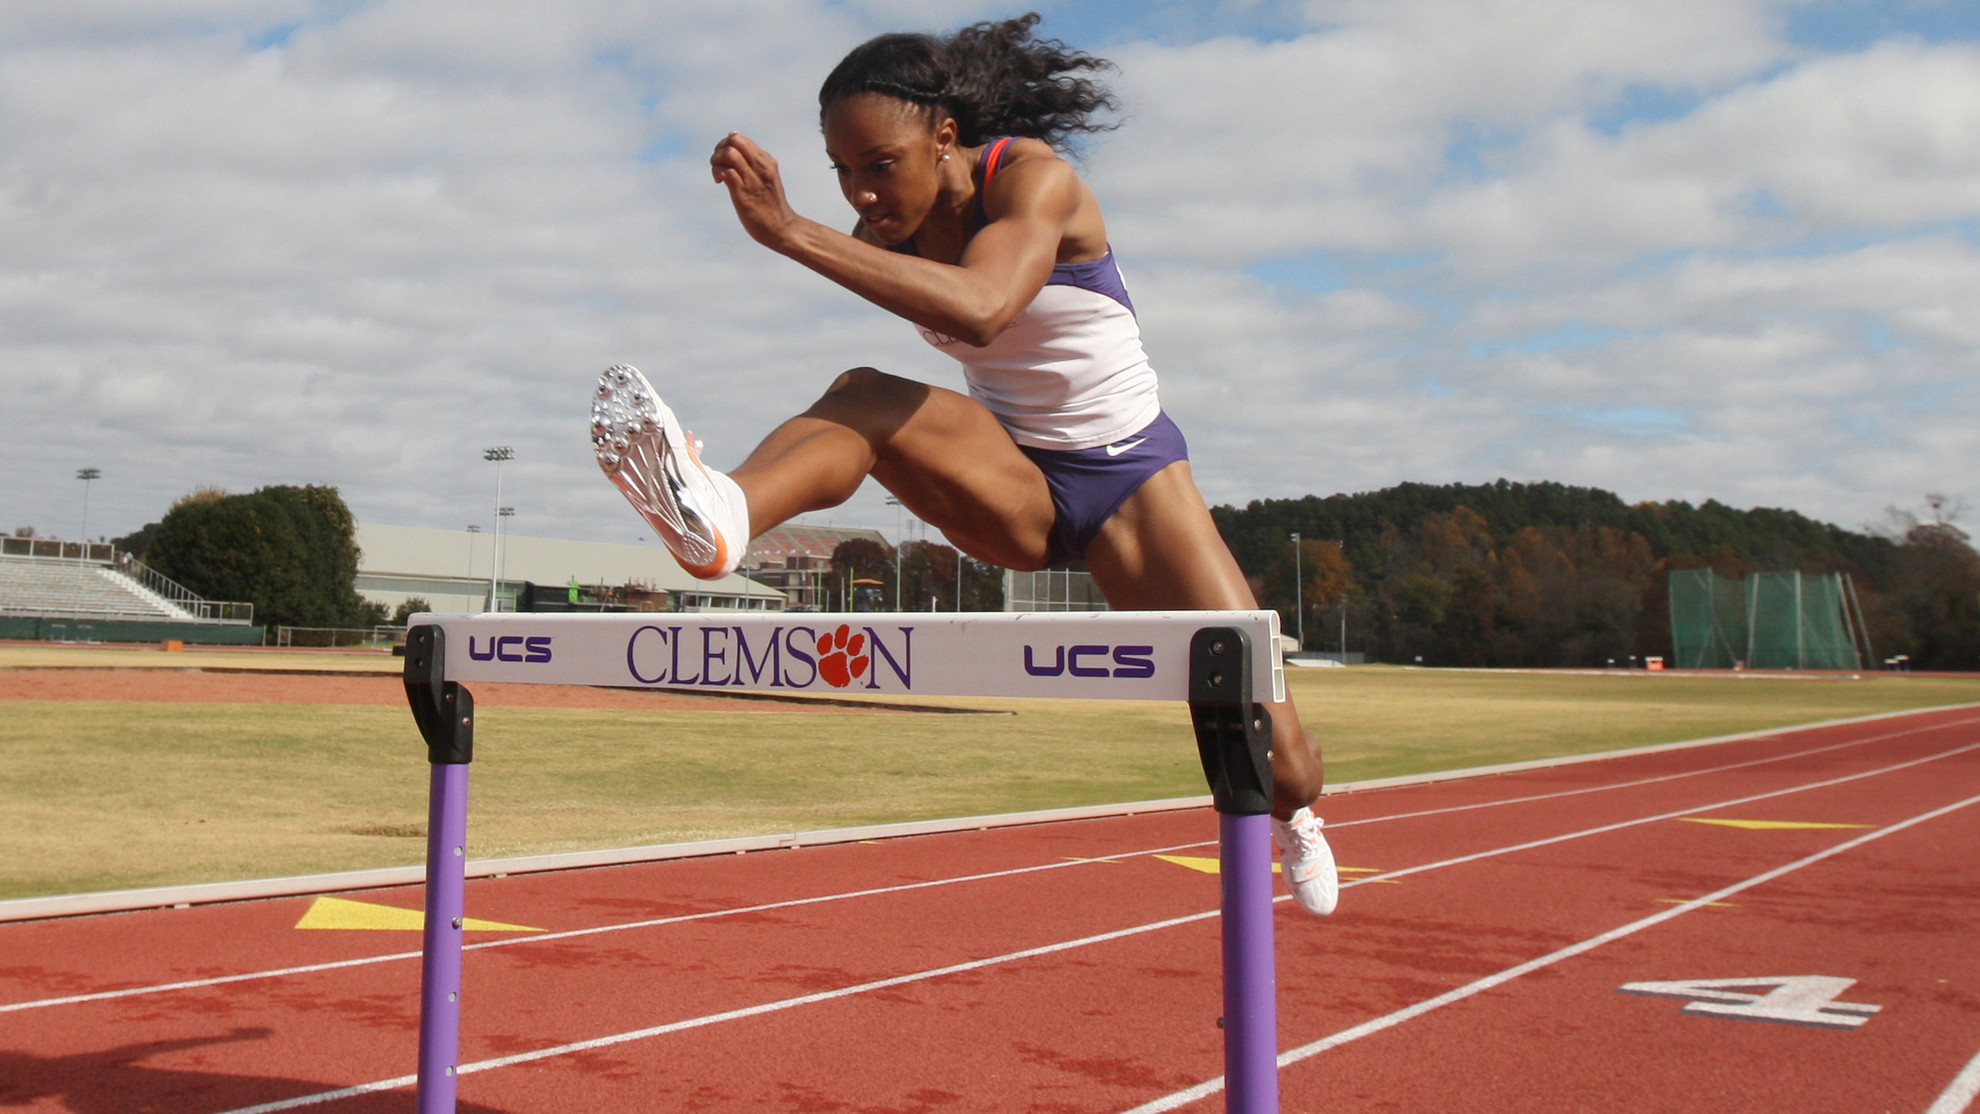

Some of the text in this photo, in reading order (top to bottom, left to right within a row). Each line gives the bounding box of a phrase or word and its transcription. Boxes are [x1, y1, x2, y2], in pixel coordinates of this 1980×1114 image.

[469, 635, 552, 663] UCS
[1024, 645, 1155, 678] UCS
[1614, 975, 1882, 1031] 4
